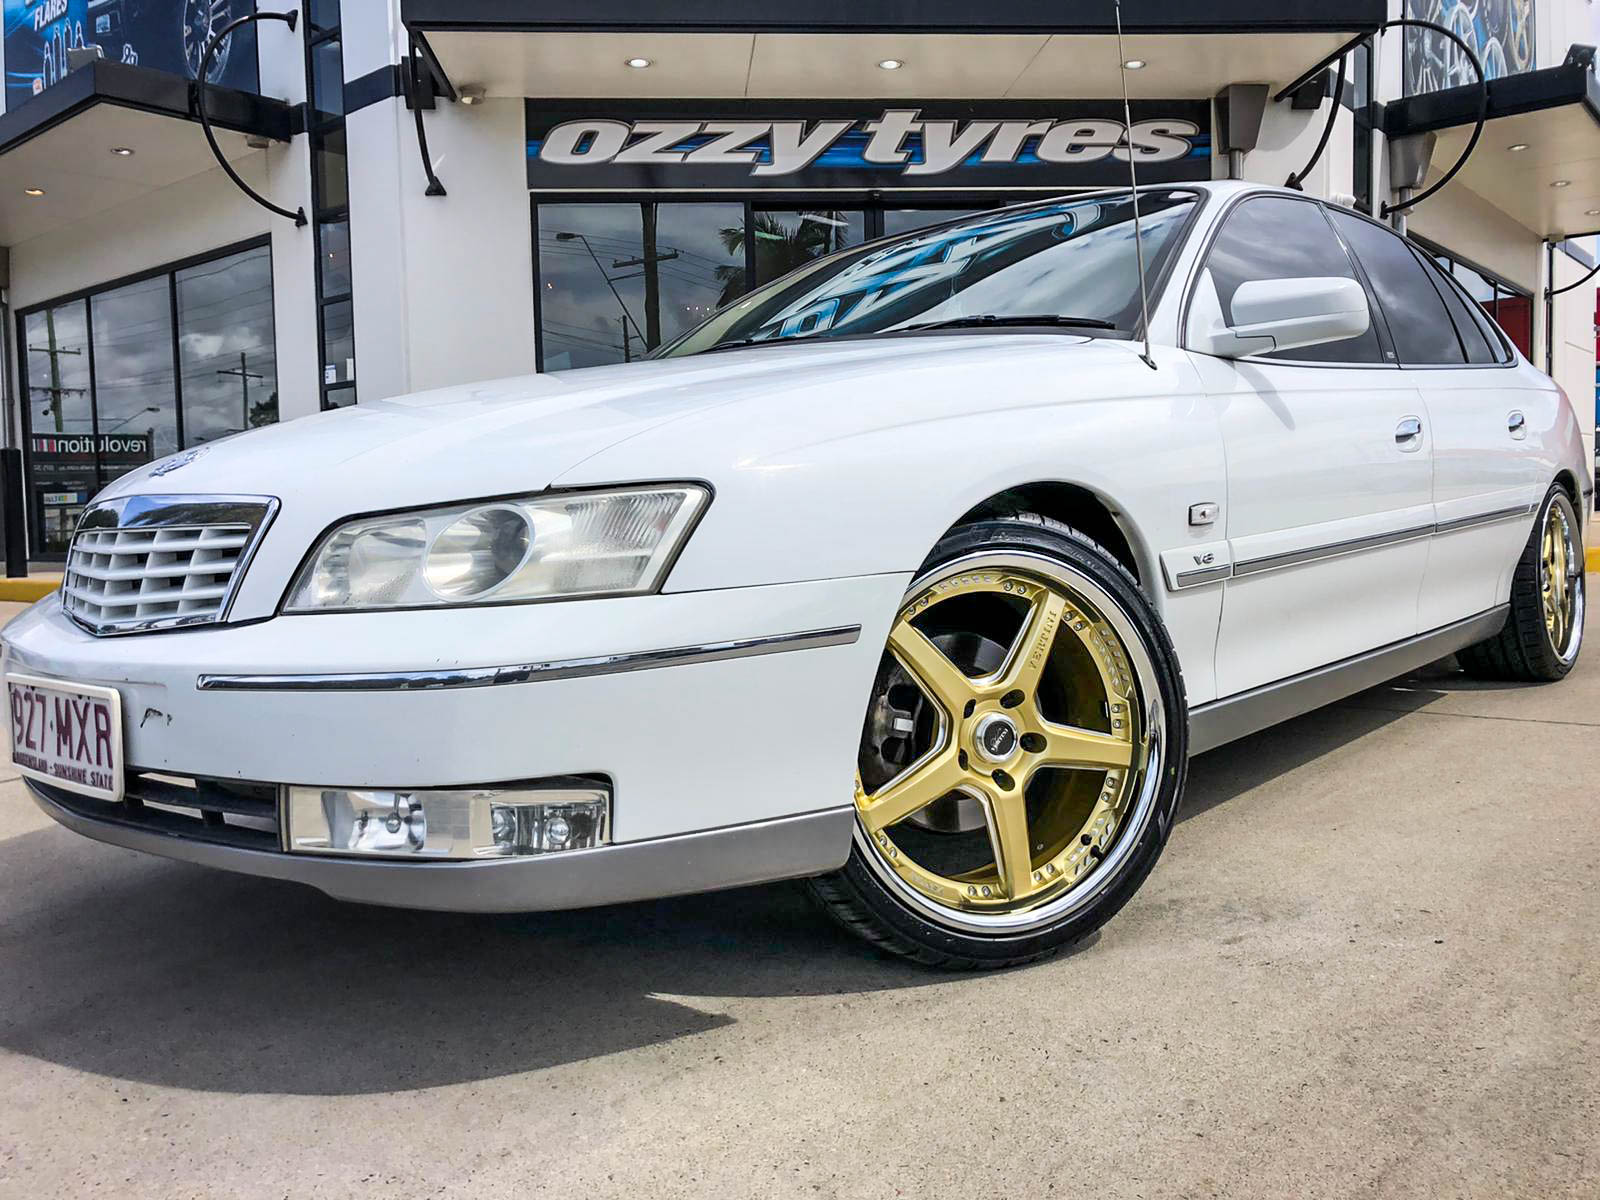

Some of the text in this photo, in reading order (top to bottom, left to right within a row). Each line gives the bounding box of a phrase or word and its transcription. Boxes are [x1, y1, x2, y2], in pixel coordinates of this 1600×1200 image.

[34, 0, 68, 32] FLARES
[539, 107, 1200, 178] ozzy tyres
[1193, 552, 1214, 566] V6
